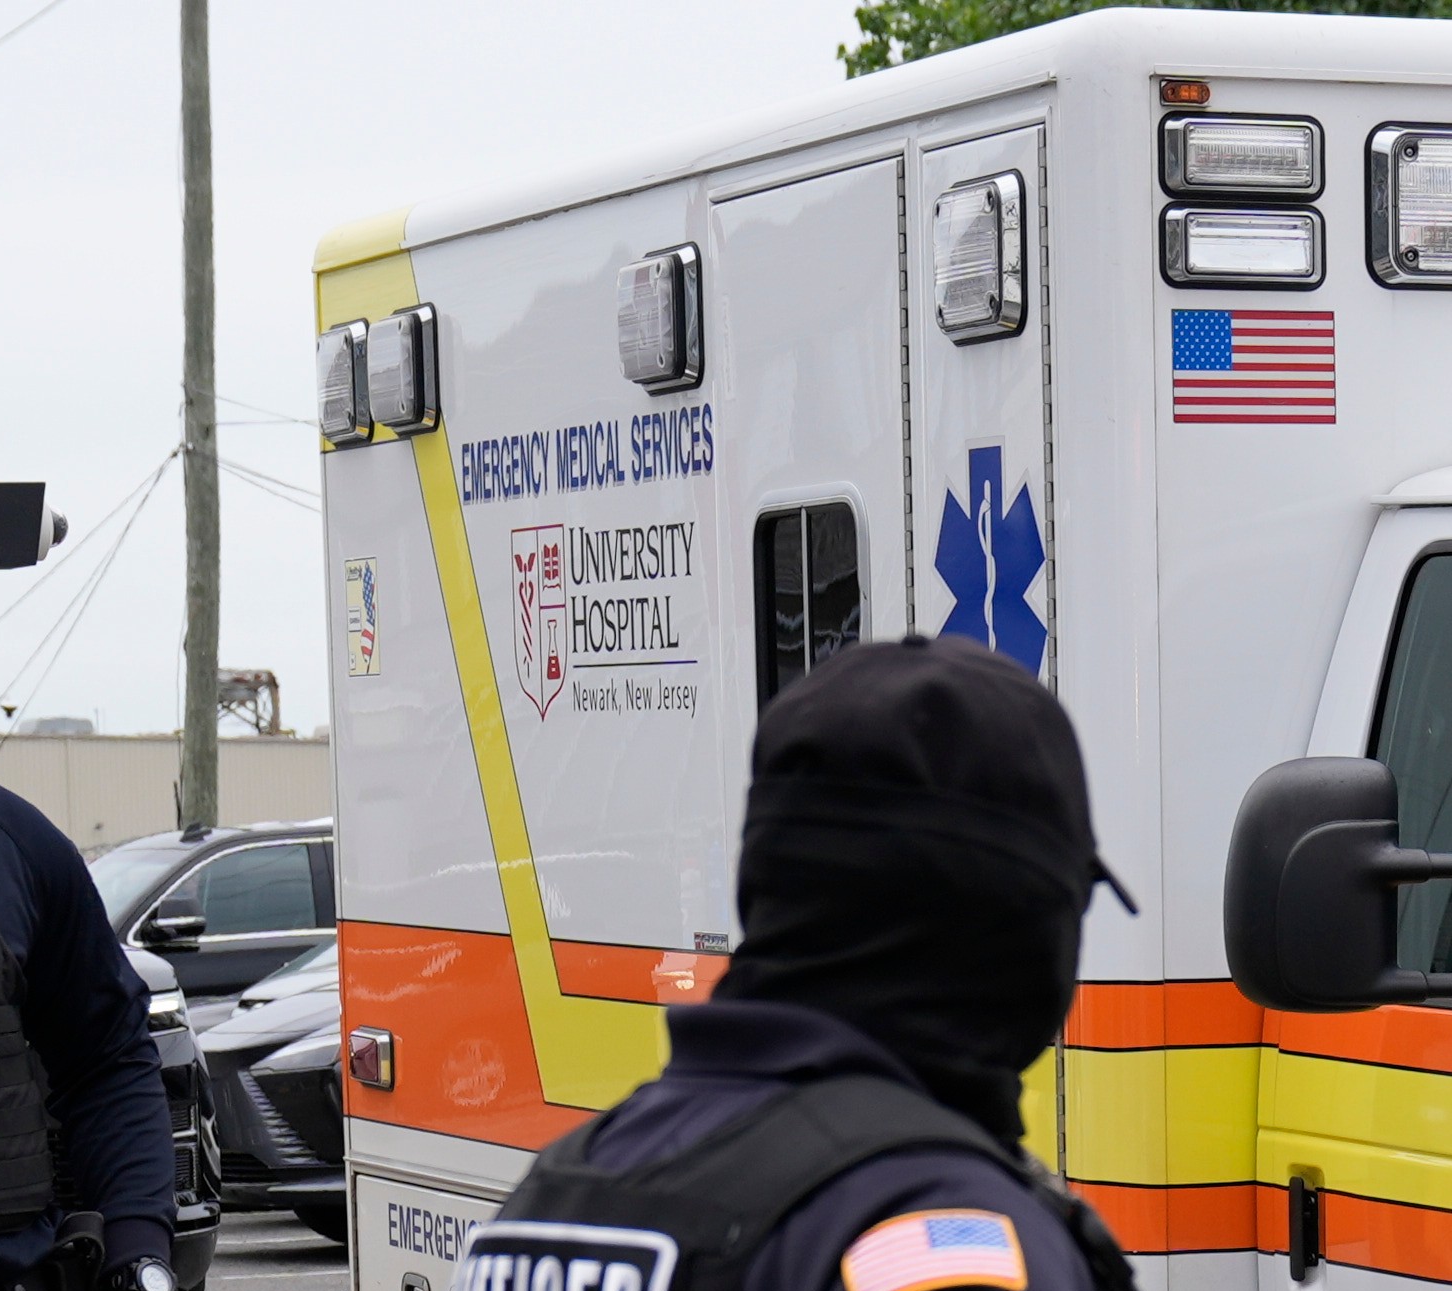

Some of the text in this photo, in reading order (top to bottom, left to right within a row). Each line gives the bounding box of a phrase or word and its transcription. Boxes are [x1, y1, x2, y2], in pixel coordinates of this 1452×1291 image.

[461, 402, 714, 504] EMERGENCY MEDICAL SERVICES
[569, 522, 695, 585] UNIVERSITY
[571, 595, 679, 654] HOSPITAL
[573, 677, 698, 719] Newark, New Jersey
[388, 1202, 480, 1262] EMERGEN
